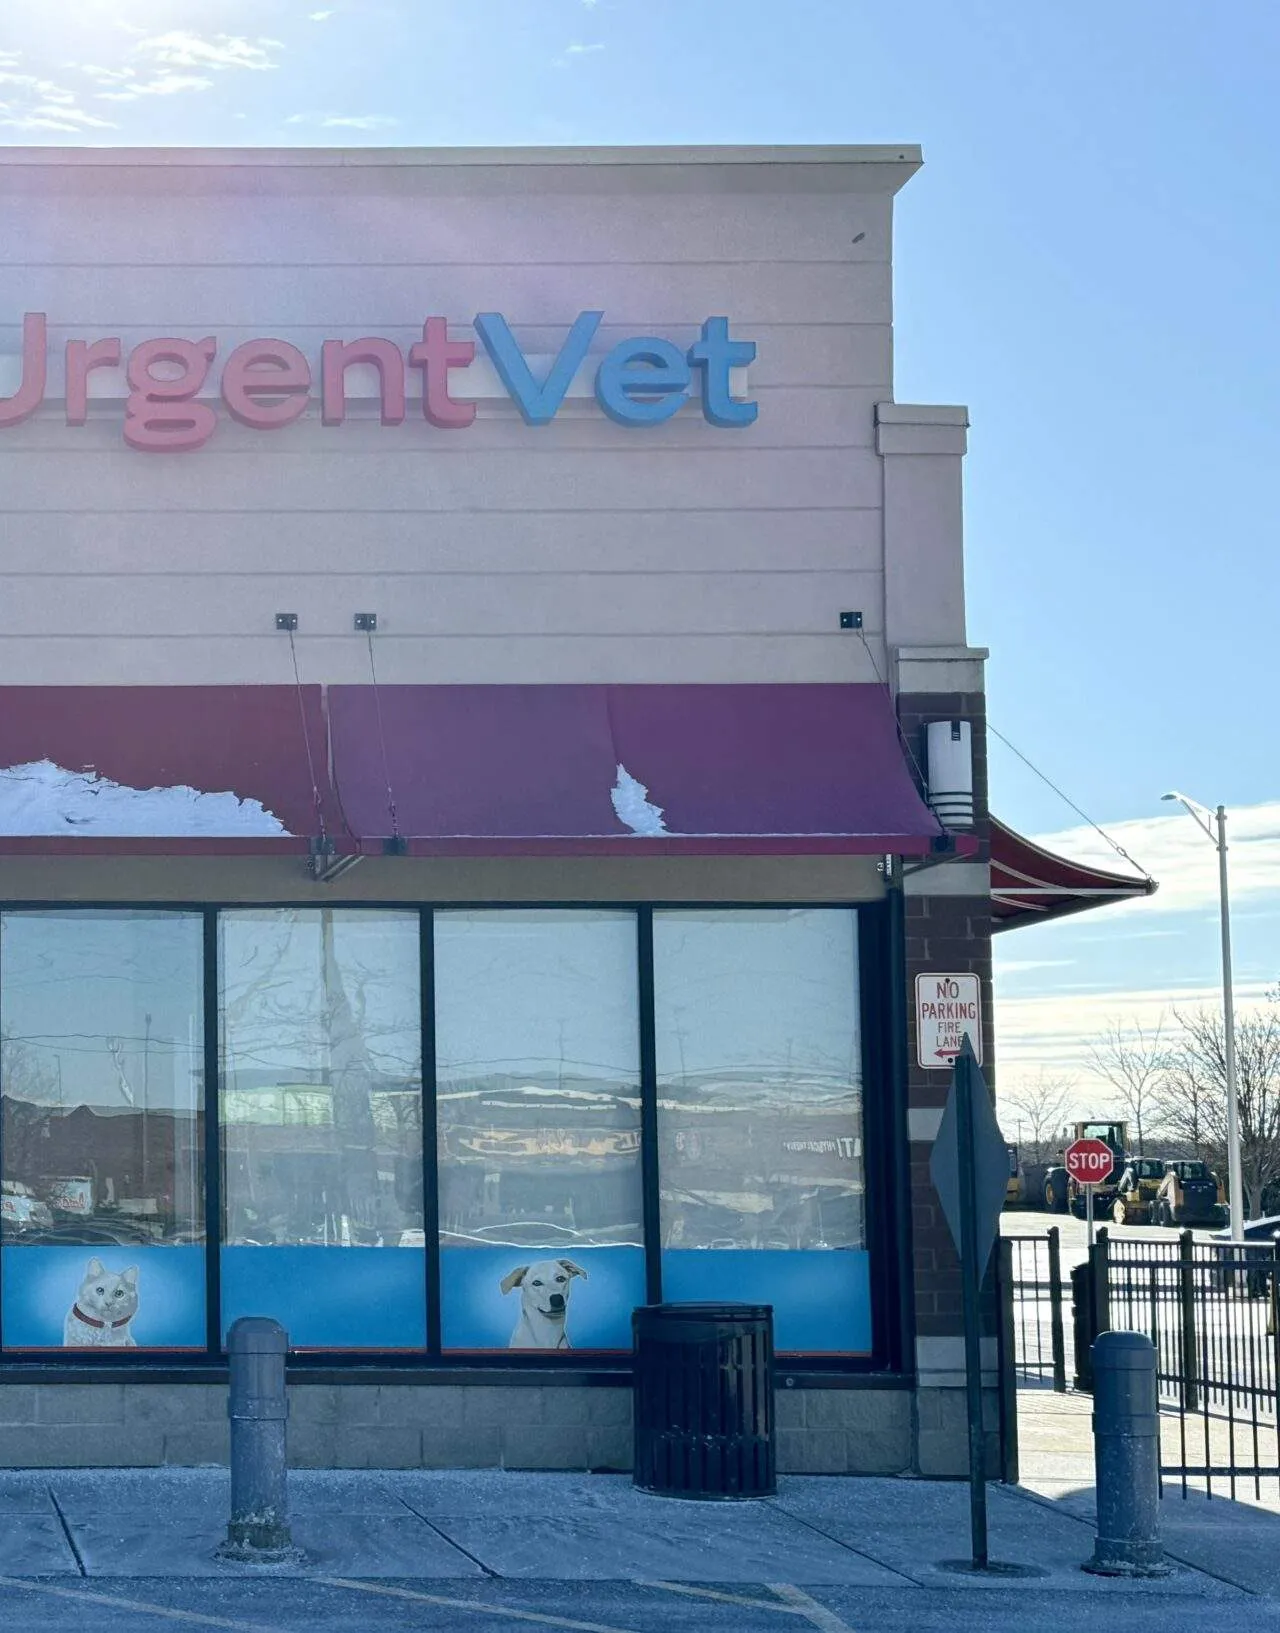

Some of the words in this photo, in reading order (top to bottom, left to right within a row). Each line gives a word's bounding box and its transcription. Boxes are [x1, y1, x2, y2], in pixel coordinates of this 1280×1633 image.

[936, 982, 960, 999] NO
[921, 1002, 976, 1019] PARKING
[938, 1022, 962, 1033] FIRE
[1069, 1153, 1110, 1170] STOP
